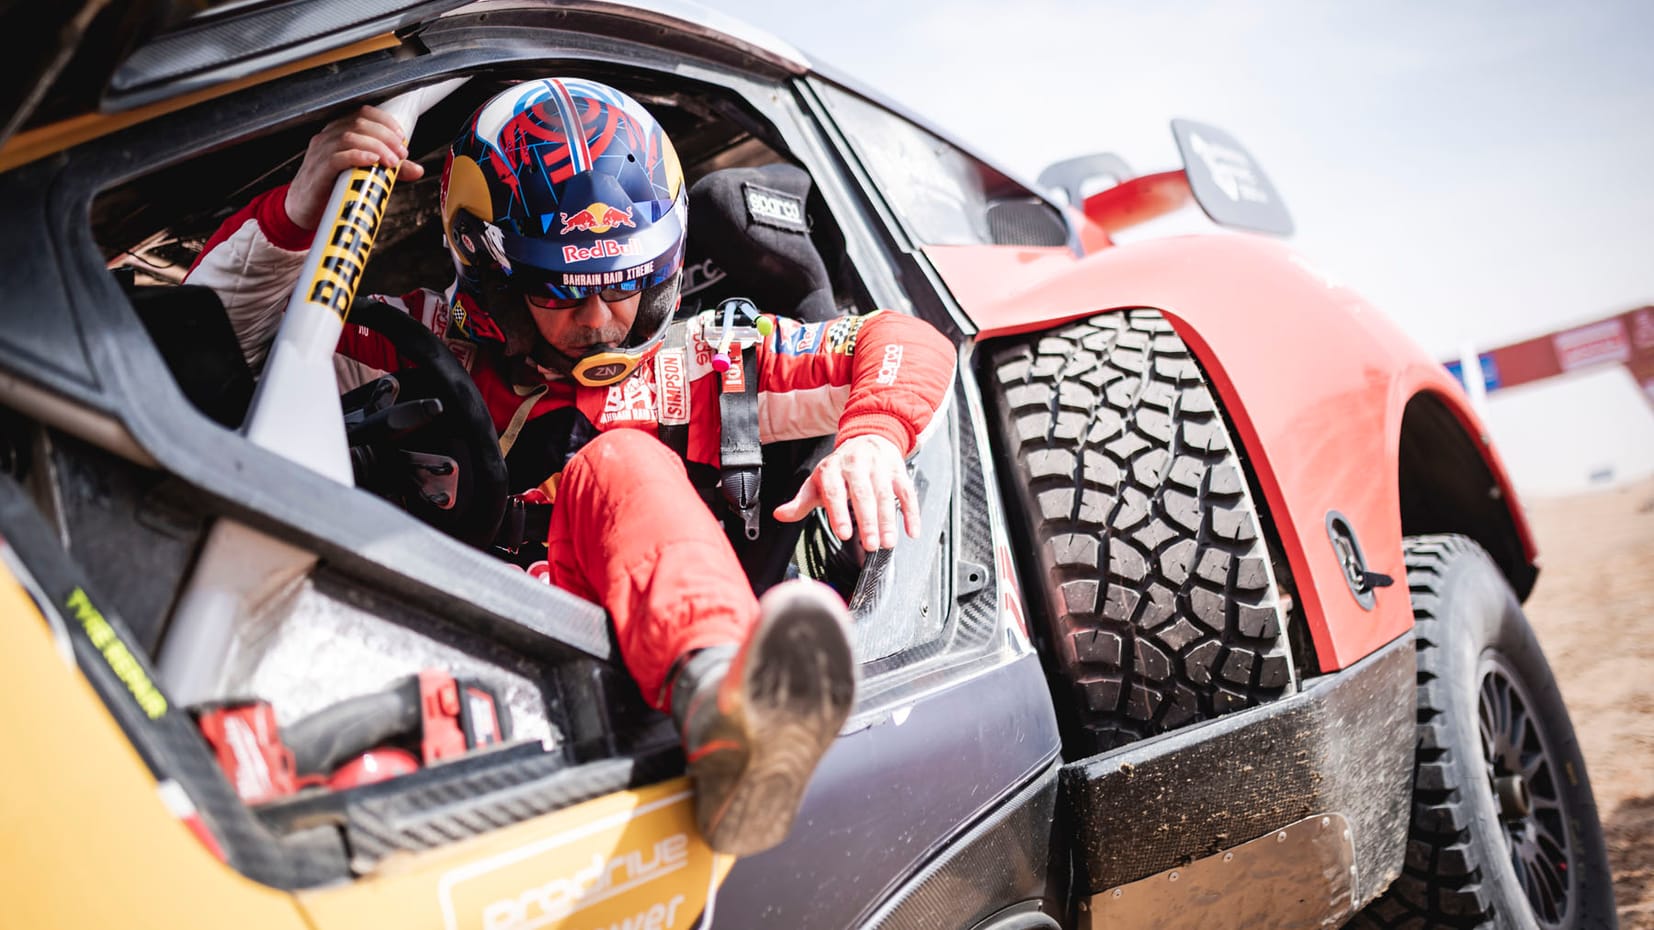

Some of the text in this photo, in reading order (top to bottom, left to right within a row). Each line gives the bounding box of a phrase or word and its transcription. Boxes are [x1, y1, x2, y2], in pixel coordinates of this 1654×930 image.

[562, 240, 605, 263] Red
[562, 261, 655, 286] BAHRAIN RAID XTREME
[663, 356, 682, 416] SIMPSON
